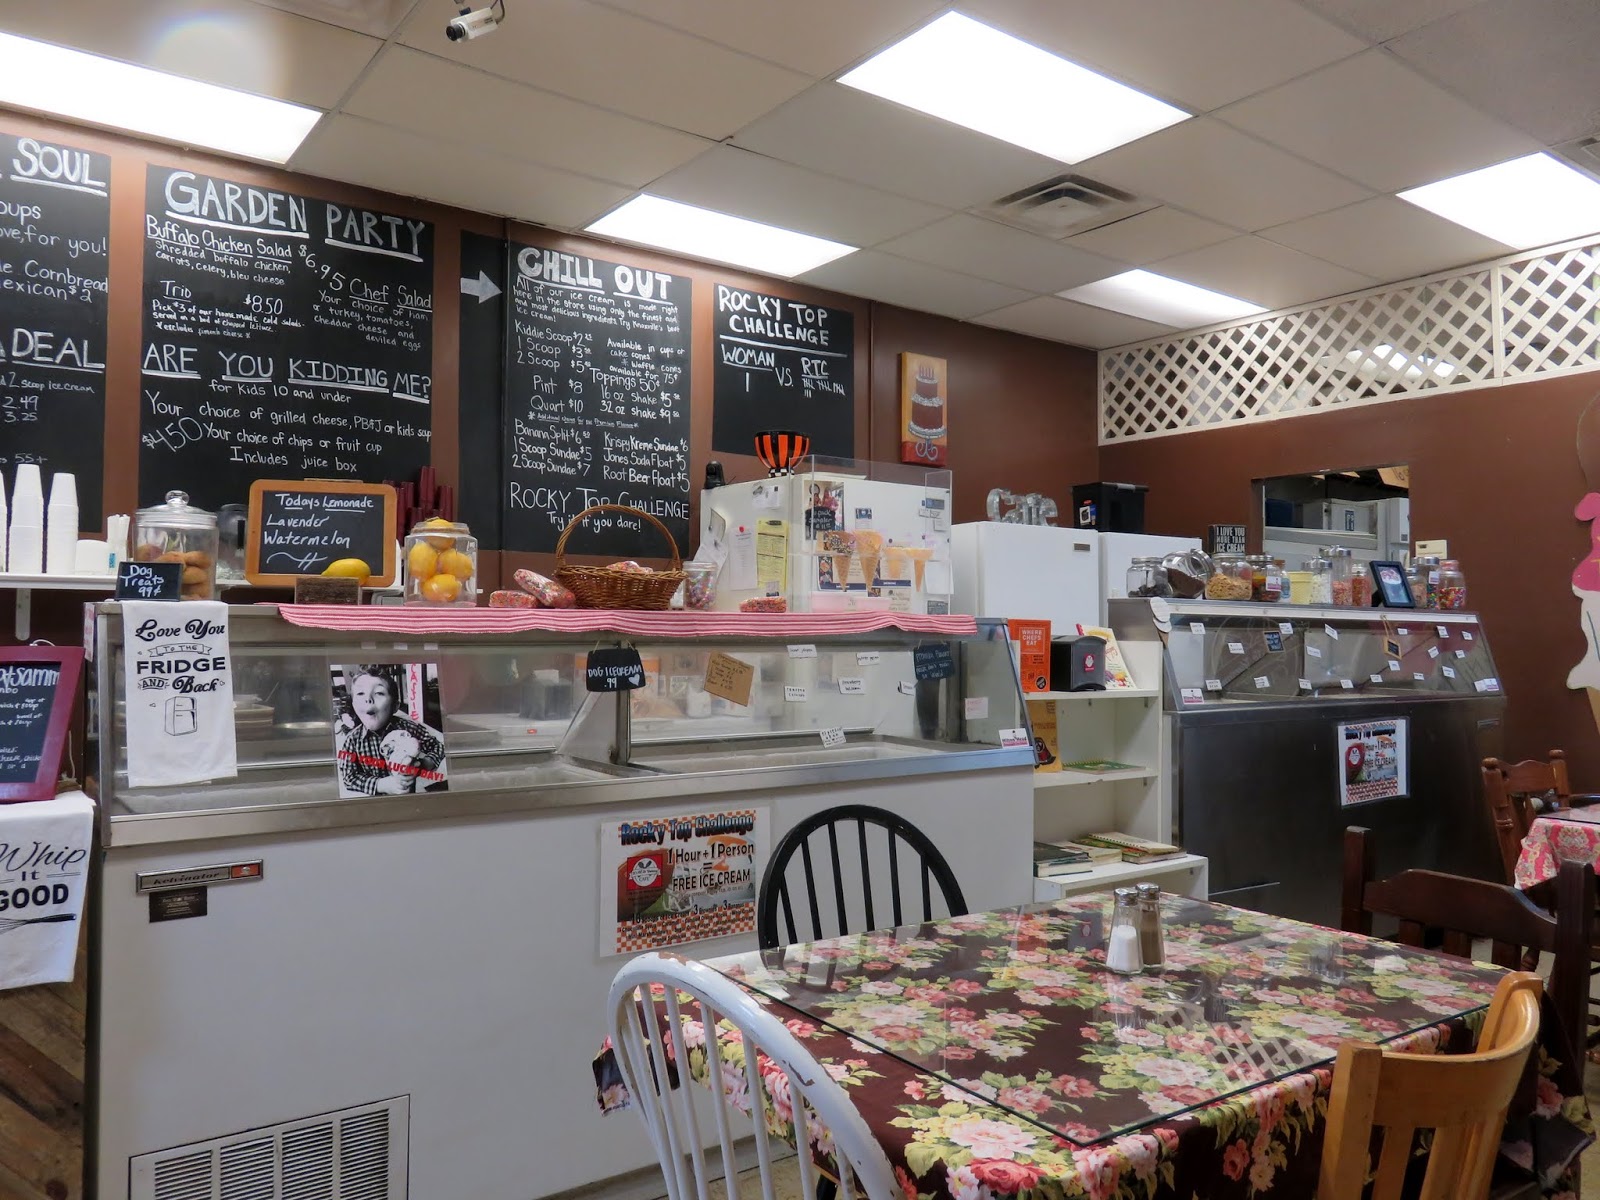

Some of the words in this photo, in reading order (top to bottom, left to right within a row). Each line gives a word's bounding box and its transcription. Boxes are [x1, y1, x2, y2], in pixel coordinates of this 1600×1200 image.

[13, 138, 106, 187] SOUL
[165, 171, 308, 231] GARDEN
[326, 203, 426, 255] PARTY
[24, 224, 60, 245] for
[68, 237, 106, 258] you!
[146, 215, 200, 245] Buffalo
[202, 230, 253, 255] Chicken
[257, 238, 292, 258] Salad
[155, 240, 206, 259] shredded
[213, 254, 249, 267] buffalo
[254, 261, 291, 273] chicken,
[25, 260, 108, 293] Cornbread
[254, 274, 285, 286] cheese
[517, 247, 603, 288] CHILL
[614, 265, 672, 300] OUT
[0, 279, 67, 300] exican
[160, 280, 192, 299] Trio
[349, 278, 390, 302] Chef
[398, 285, 432, 309] Salad
[513, 285, 533, 299] here
[570, 290, 583, 300] ice
[588, 294, 615, 306] cream
[243, 293, 283, 315] $8.50
[319, 290, 342, 304] Your
[352, 300, 385, 313] choice
[552, 306, 580, 318] delicious
[718, 285, 781, 321] ROCKY
[788, 303, 828, 327] TOP
[314, 315, 352, 328] cheddar
[358, 323, 388, 335] cheese
[398, 331, 415, 339] and
[329, 306, 363, 321] turkey,
[366, 313, 414, 329] tomatoes,
[366, 333, 396, 346] deviled
[402, 340, 422, 351] eggs
[515, 319, 545, 339] Kiddie
[546, 327, 573, 347] Scoop
[729, 315, 829, 347] CHALLENGE
[12, 328, 105, 369] DEAL
[527, 337, 561, 359] Scoop
[607, 337, 642, 351] Available
[142, 343, 198, 374] ARE
[218, 351, 274, 378] YOU
[289, 358, 388, 387] KIDDING
[394, 372, 432, 398] ME?
[527, 351, 560, 373] Scoop
[721, 343, 775, 367] WOMAN
[800, 357, 829, 376] RTC
[589, 367, 637, 391] Toppings
[609, 365, 641, 378] available
[21, 379, 45, 391] scoop
[209, 379, 233, 393] for
[293, 389, 314, 399] and
[321, 391, 351, 403] under
[533, 375, 558, 394] Pint
[568, 378, 583, 394] $8
[600, 383, 611, 399] 16
[2, 395, 39, 410] 2.49
[145, 390, 184, 414] Your
[199, 402, 241, 418] choice
[250, 407, 264, 420] of
[270, 409, 306, 425] grilled
[312, 414, 352, 430] cheese,
[384, 424, 395, 434] or
[397, 421, 415, 437] kids
[530, 395, 565, 413] Quart
[568, 398, 584, 413] $10
[600, 399, 613, 413] 32
[4, 411, 38, 422] 3.25
[203, 422, 231, 441] Your
[236, 431, 268, 444] choice
[272, 432, 286, 445] of
[288, 436, 313, 452] chips
[319, 439, 331, 448] or
[335, 438, 361, 451] fruit
[366, 442, 382, 455] cup
[514, 418, 550, 440] Banana
[549, 424, 571, 445] Split
[604, 431, 630, 452] Krispy
[630, 434, 653, 451] Kreme
[653, 437, 679, 452] Sundae
[230, 445, 288, 467] Includes
[300, 455, 328, 469] juice
[335, 457, 357, 473] box
[518, 437, 547, 460] Scoop
[549, 442, 581, 460] Sundae
[580, 446, 593, 461] $5
[603, 447, 629, 465] Jones
[630, 451, 651, 466] Soda
[651, 453, 674, 469] Float
[675, 452, 687, 471] $5
[521, 453, 547, 475] Scoop
[547, 458, 577, 475] Sundae
[577, 461, 591, 477] $7
[603, 465, 628, 481] Root
[628, 467, 651, 485] Beer
[652, 469, 677, 488] Float
[676, 471, 691, 493] $5
[275, 493, 320, 509] Todays
[322, 496, 374, 508] Lemonade
[510, 481, 571, 513] ROCKY
[266, 514, 330, 527] Lavender
[547, 511, 565, 532] Try
[593, 515, 613, 533] you
[617, 515, 641, 532] dare!
[1220, 526, 1233, 536] LOVE
[264, 530, 351, 548] Watermelon
[119, 575, 164, 587] Treats
[129, 565, 153, 579] Dog
[138, 586, 162, 598] 99¢
[135, 619, 181, 642] Love
[184, 619, 225, 640] You
[137, 657, 226, 675] FRIDGE
[588, 667, 604, 678] DOG
[142, 678, 164, 688] AND
[172, 675, 219, 694] Back
[604, 677, 617, 688] .99
[388, 761, 420, 776] LUCKY
[420, 768, 444, 781] DAY!
[620, 821, 665, 845] Rocky
[669, 819, 692, 842] Top
[695, 813, 754, 837] Challenge
[0, 842, 87, 872] Whip
[676, 848, 701, 864] Hour
[718, 843, 754, 858] Person
[22, 870, 40, 881] It
[673, 875, 697, 891] FREE
[699, 873, 714, 888] ICE
[717, 869, 750, 884] CREAM
